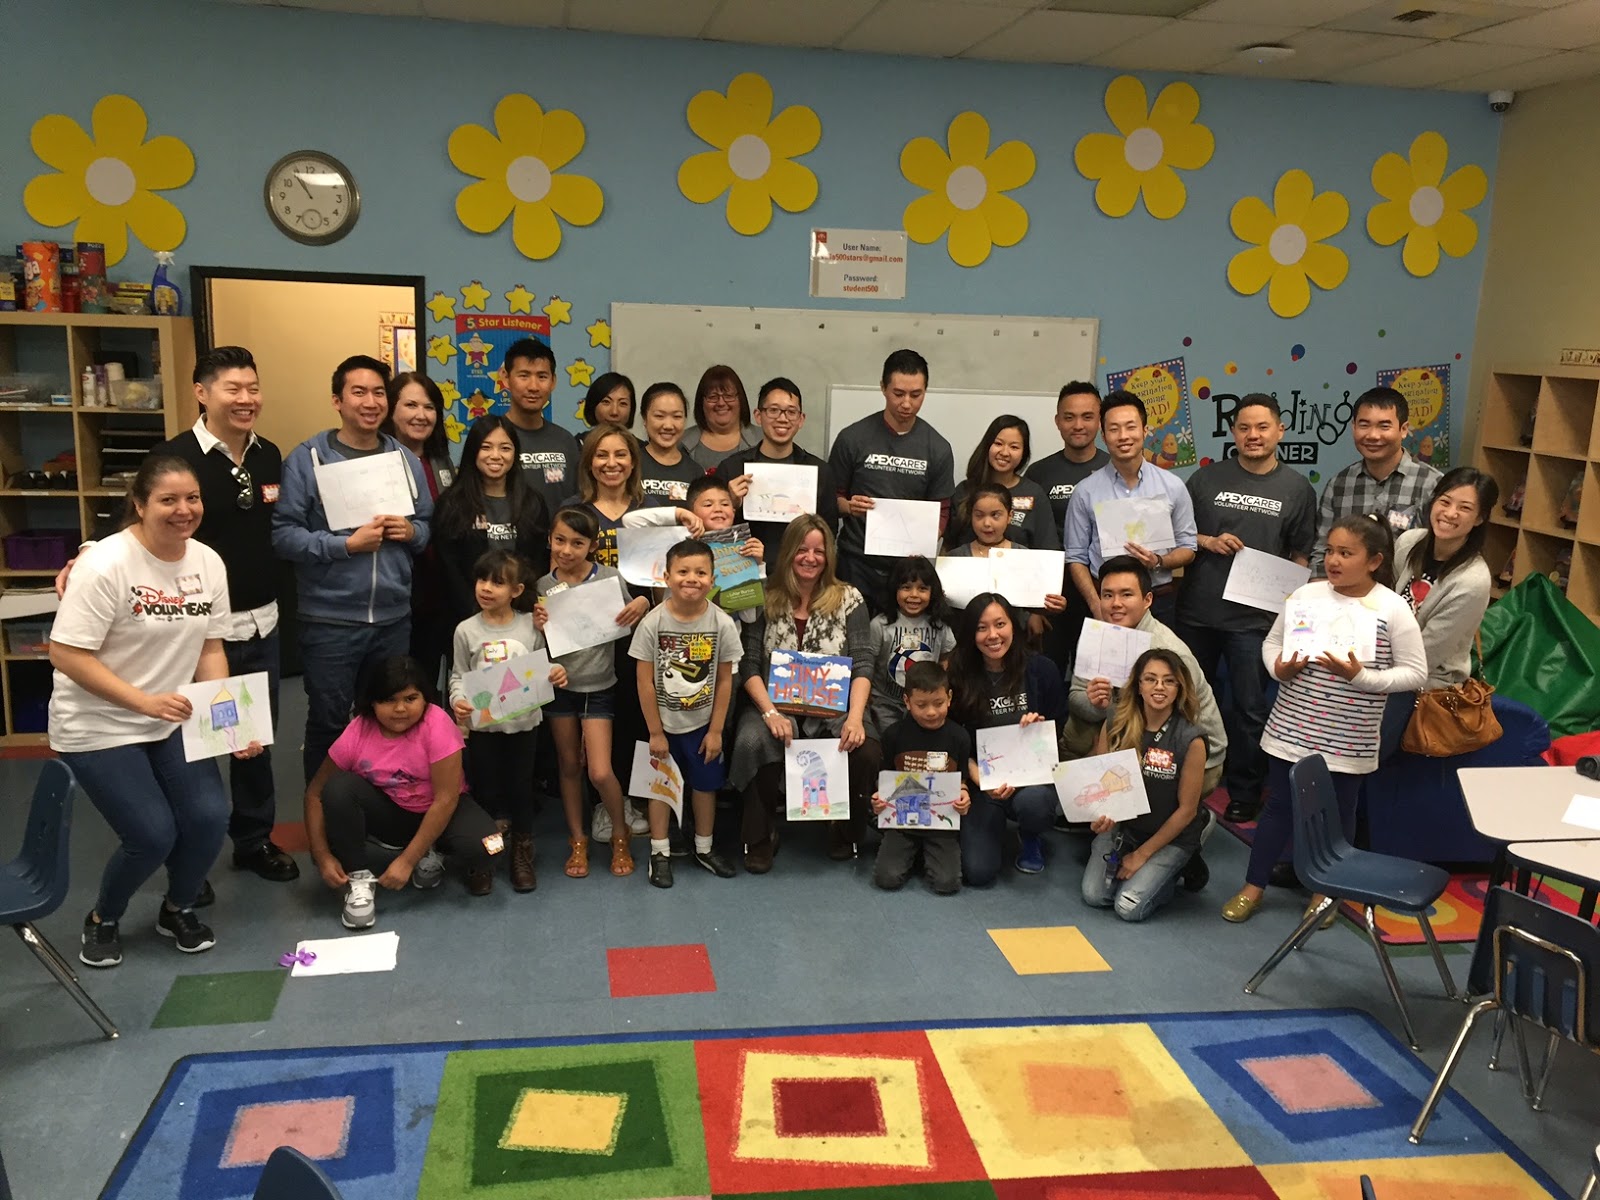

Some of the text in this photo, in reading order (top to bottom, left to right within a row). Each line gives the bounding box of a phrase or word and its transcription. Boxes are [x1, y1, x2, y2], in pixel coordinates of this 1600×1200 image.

[305, 166, 315, 174] 12
[283, 178, 293, 187] 10
[279, 191, 286, 200] 9
[336, 194, 342, 203] 3
[284, 206, 291, 214] 8
[295, 215, 302, 223] 7
[323, 217, 330, 226] 5
[842, 243, 881, 252] User Name:
[843, 285, 879, 293] student500
[467, 317, 542, 330] 5 Star Listener
[864, 463, 896, 472] VOLUNTEER
[1214, 501, 1280, 517] VOLUNTEER NETWORK
[788, 663, 831, 687] TINY
[773, 681, 840, 707] HOUSE
[1143, 770, 1175, 780] NETWORK
